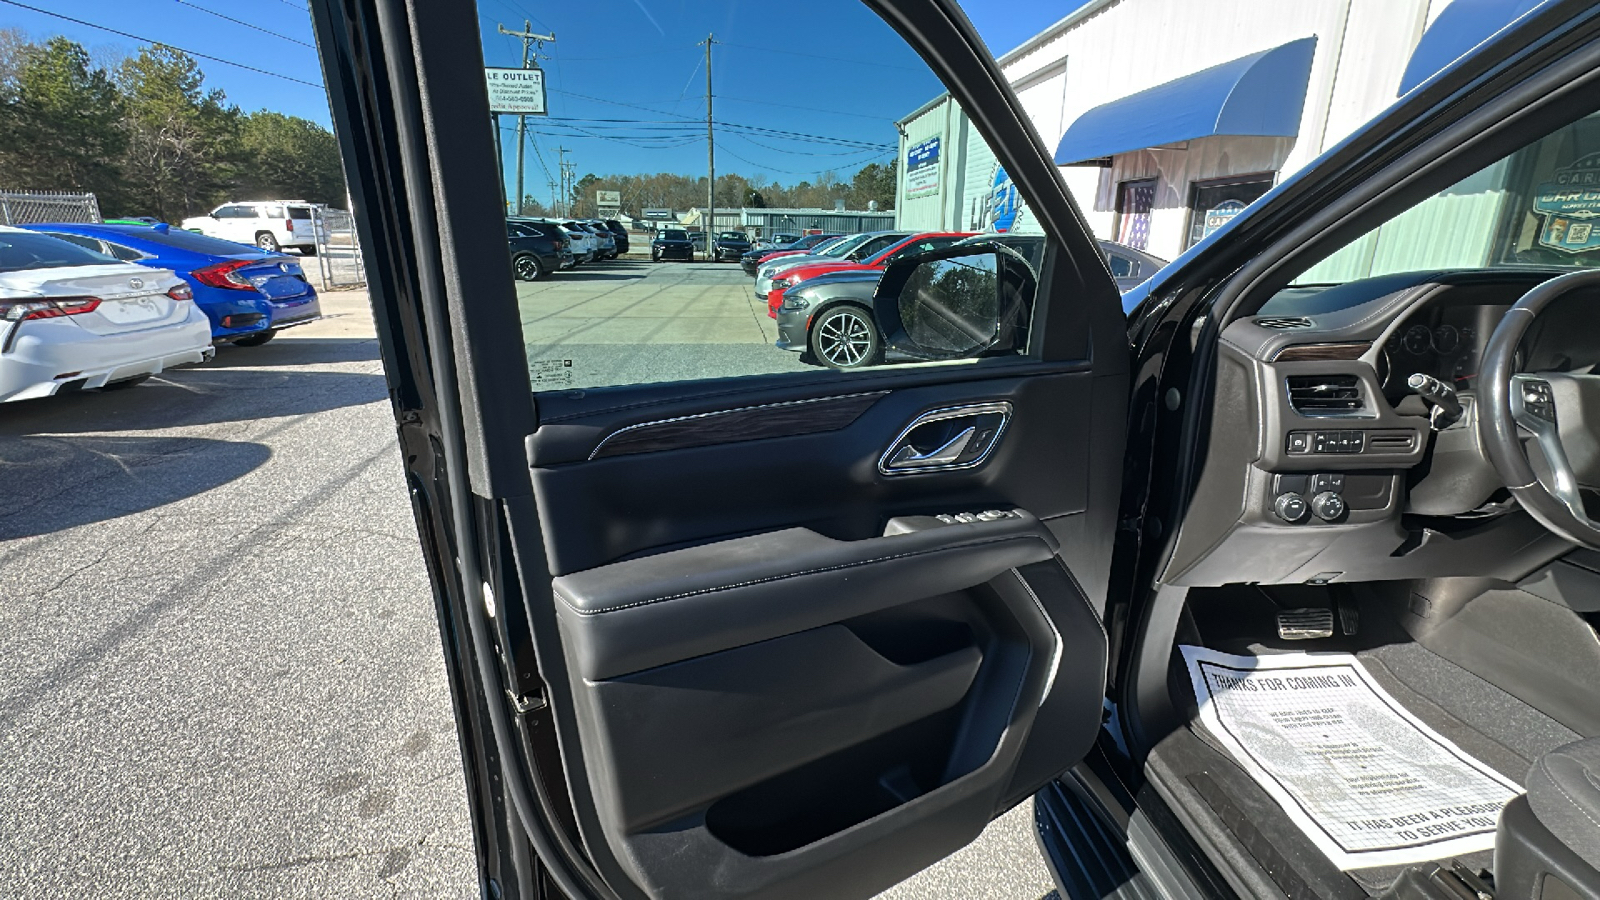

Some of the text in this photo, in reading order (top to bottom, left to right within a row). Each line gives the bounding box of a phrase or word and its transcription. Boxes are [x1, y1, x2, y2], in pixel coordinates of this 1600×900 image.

[502, 73, 540, 81] OUTLET
[1212, 673, 1358, 692] THANKS FOR COMING IN
[1346, 820, 1363, 831] IT
[1361, 818, 1393, 831] HAS
[1390, 812, 1430, 828] BEEN
[1428, 809, 1442, 820] A
[1395, 816, 1496, 841] TO SERVE YOU
